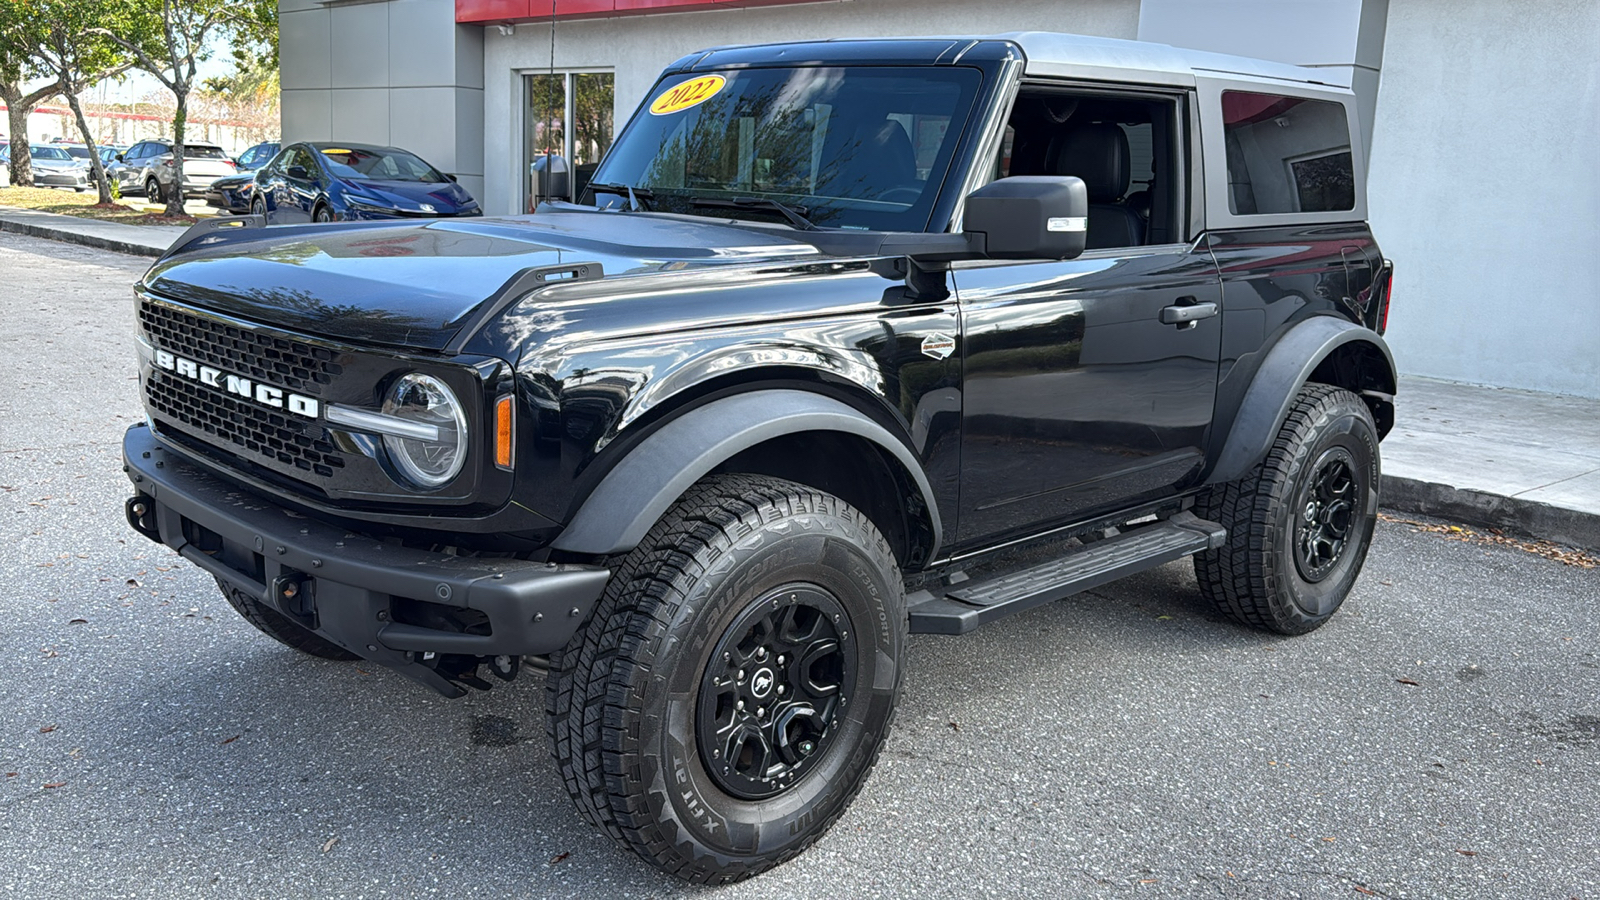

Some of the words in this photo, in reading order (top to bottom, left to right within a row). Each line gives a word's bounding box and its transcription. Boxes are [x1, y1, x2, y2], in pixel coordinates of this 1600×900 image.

[658, 79, 715, 110] 2022
[156, 349, 319, 418] BRONCO
[853, 567, 890, 645] LT315/70R17
